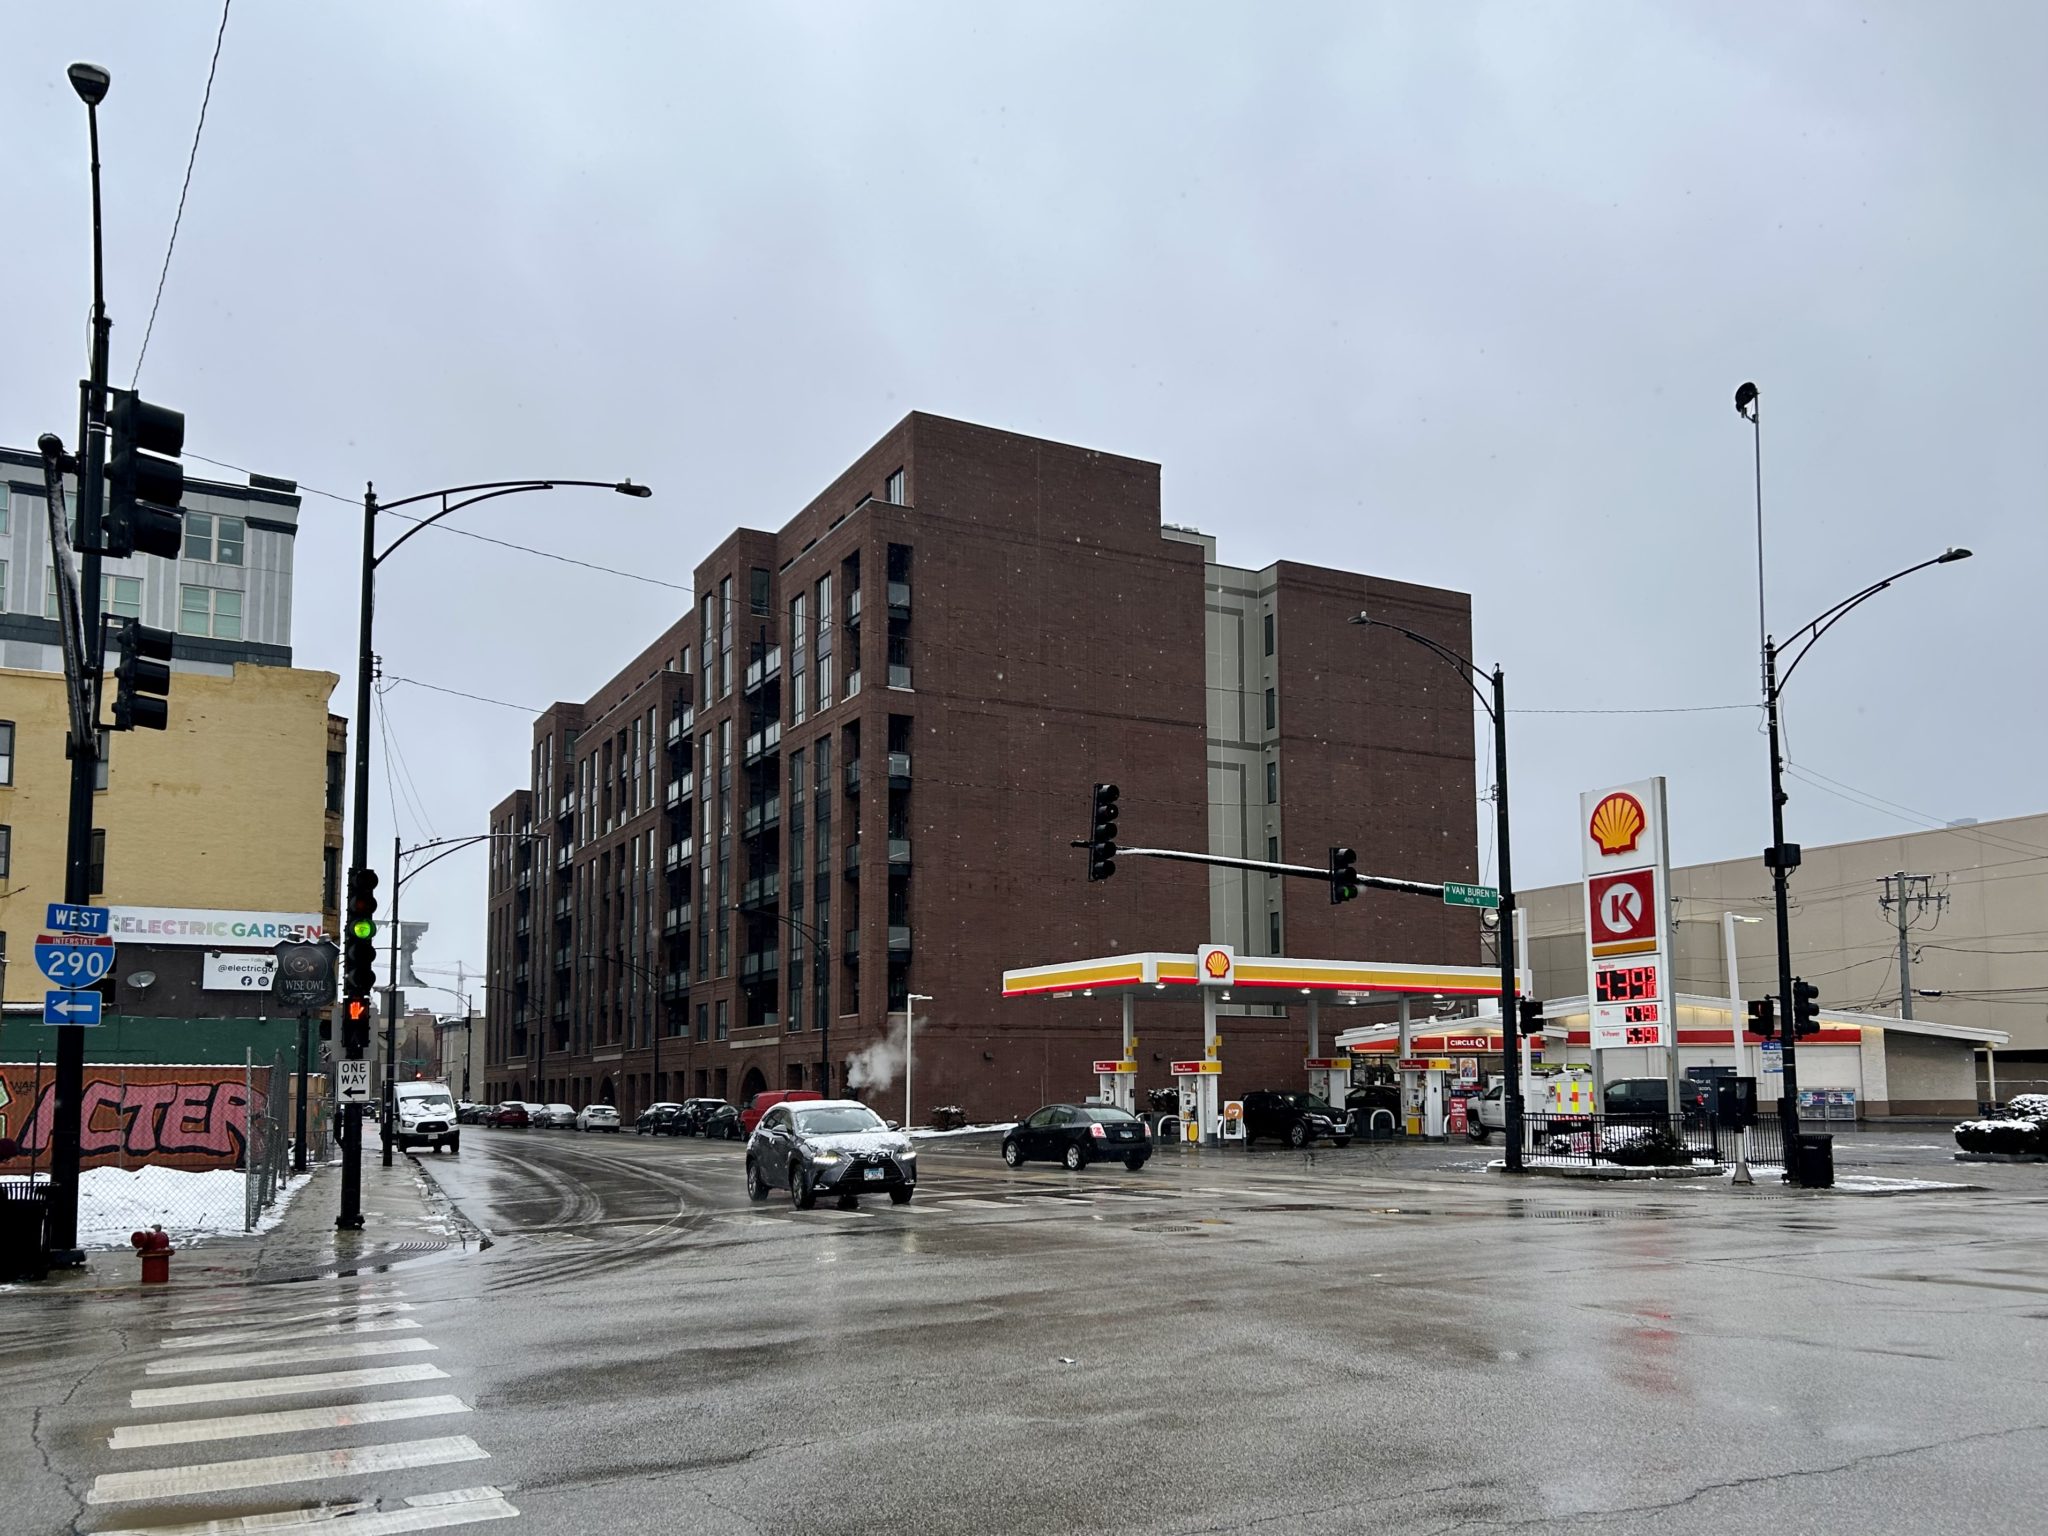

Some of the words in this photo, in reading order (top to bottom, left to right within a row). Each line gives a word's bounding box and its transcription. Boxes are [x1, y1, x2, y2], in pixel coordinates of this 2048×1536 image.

[1451, 886, 1466, 896] VAN
[1467, 887, 1490, 898] BUREN
[1609, 891, 1640, 930] K
[55, 909, 101, 928] WEST
[120, 917, 228, 937] ELECTRIC
[231, 922, 322, 940] GARDEN
[52, 937, 97, 946] INTERSTATE
[48, 951, 104, 977] 290
[286, 980, 304, 991] WISE
[306, 980, 326, 991] OWL
[1596, 968, 1646, 1001] 4.39
[342, 1062, 366, 1073] ONE
[341, 1074, 367, 1085] WAY
